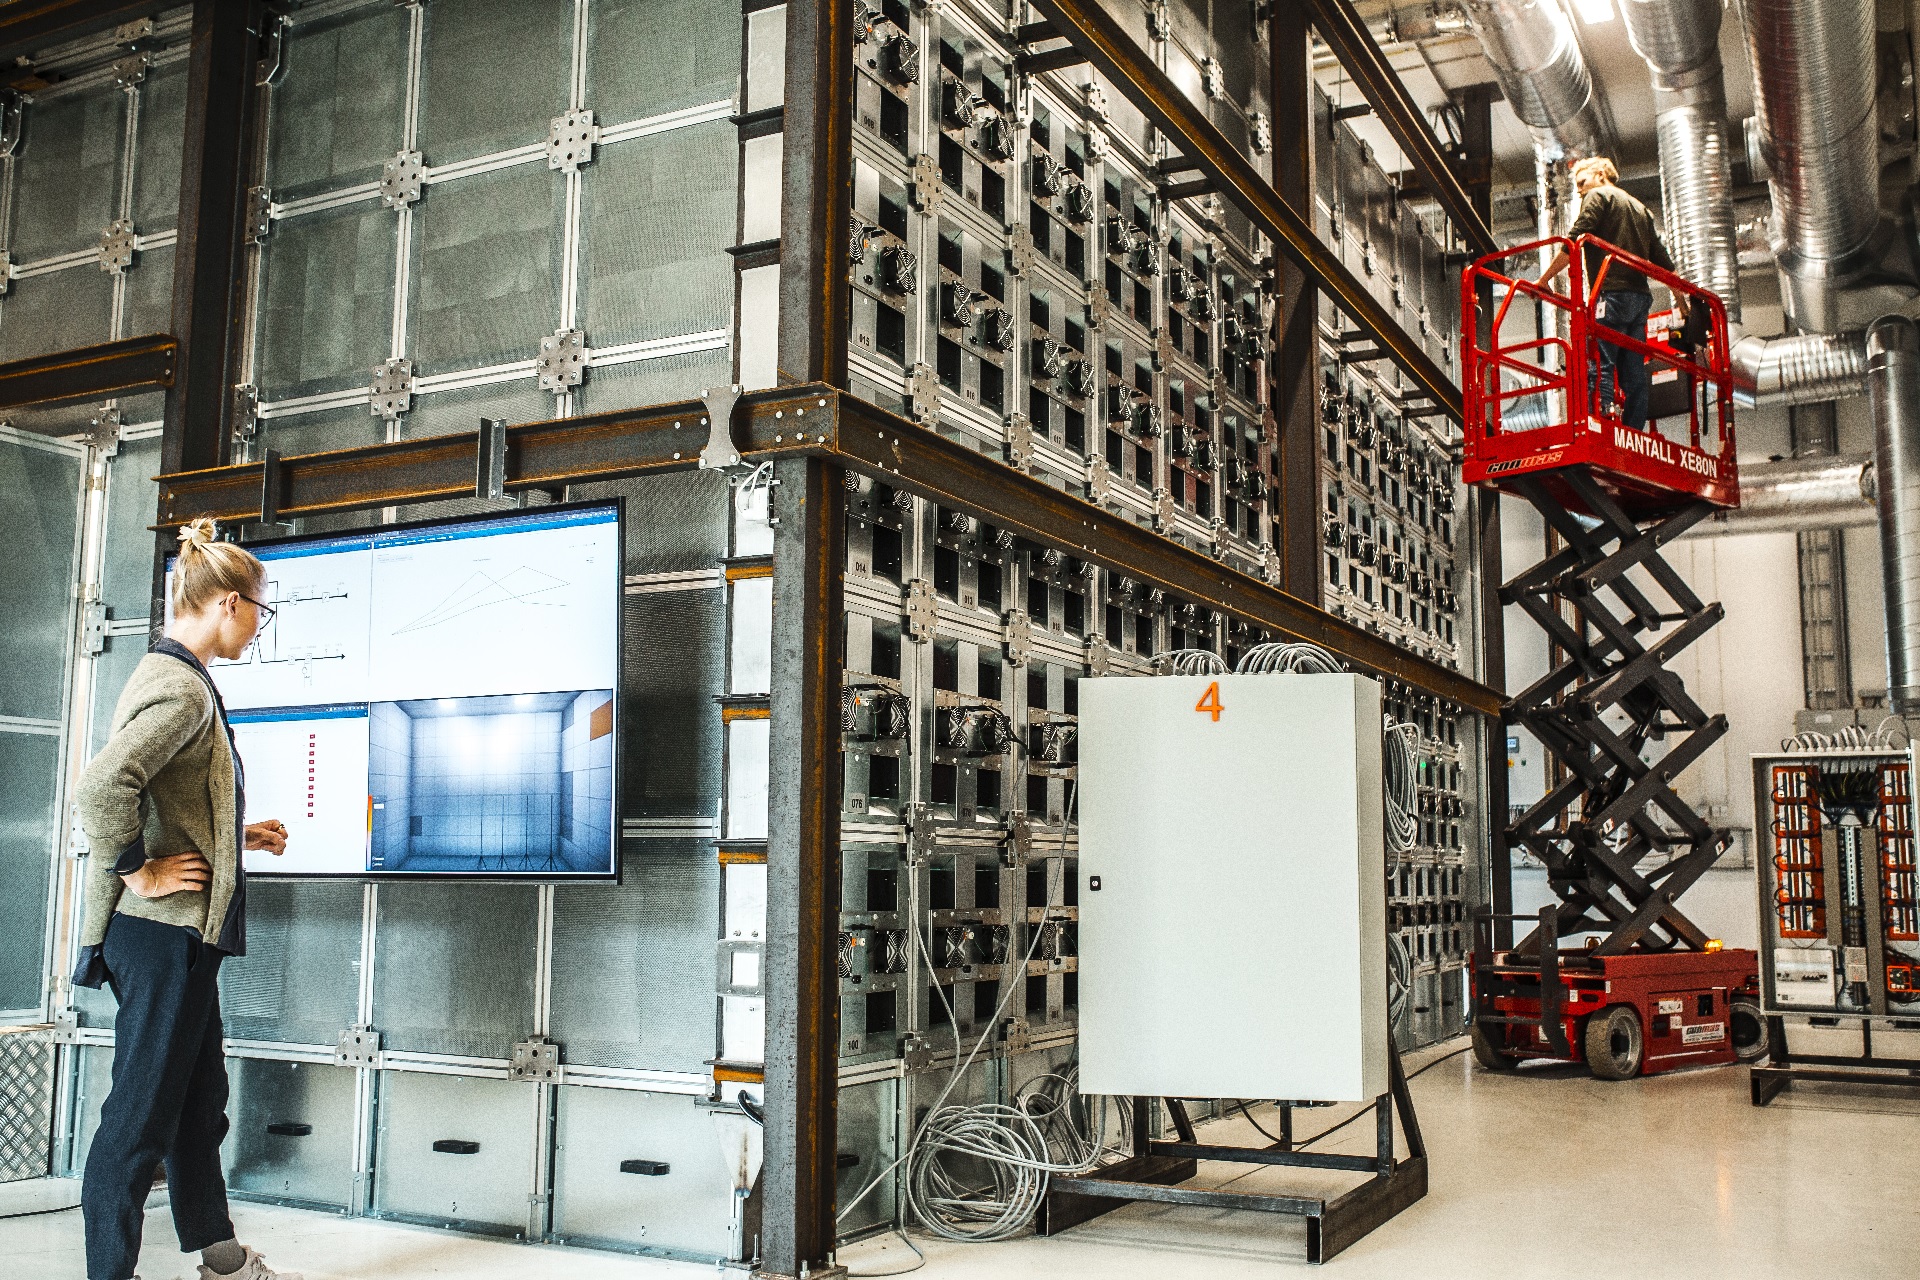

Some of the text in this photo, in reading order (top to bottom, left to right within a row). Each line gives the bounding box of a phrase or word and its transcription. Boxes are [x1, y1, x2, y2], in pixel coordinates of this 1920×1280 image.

[1614, 426, 1675, 465] MANTALL
[1680, 448, 1718, 479] XE80N
[855, 561, 867, 574] 014
[1195, 681, 1225, 722] 4
[851, 798, 863, 809] 076
[847, 1039, 859, 1051] 100
